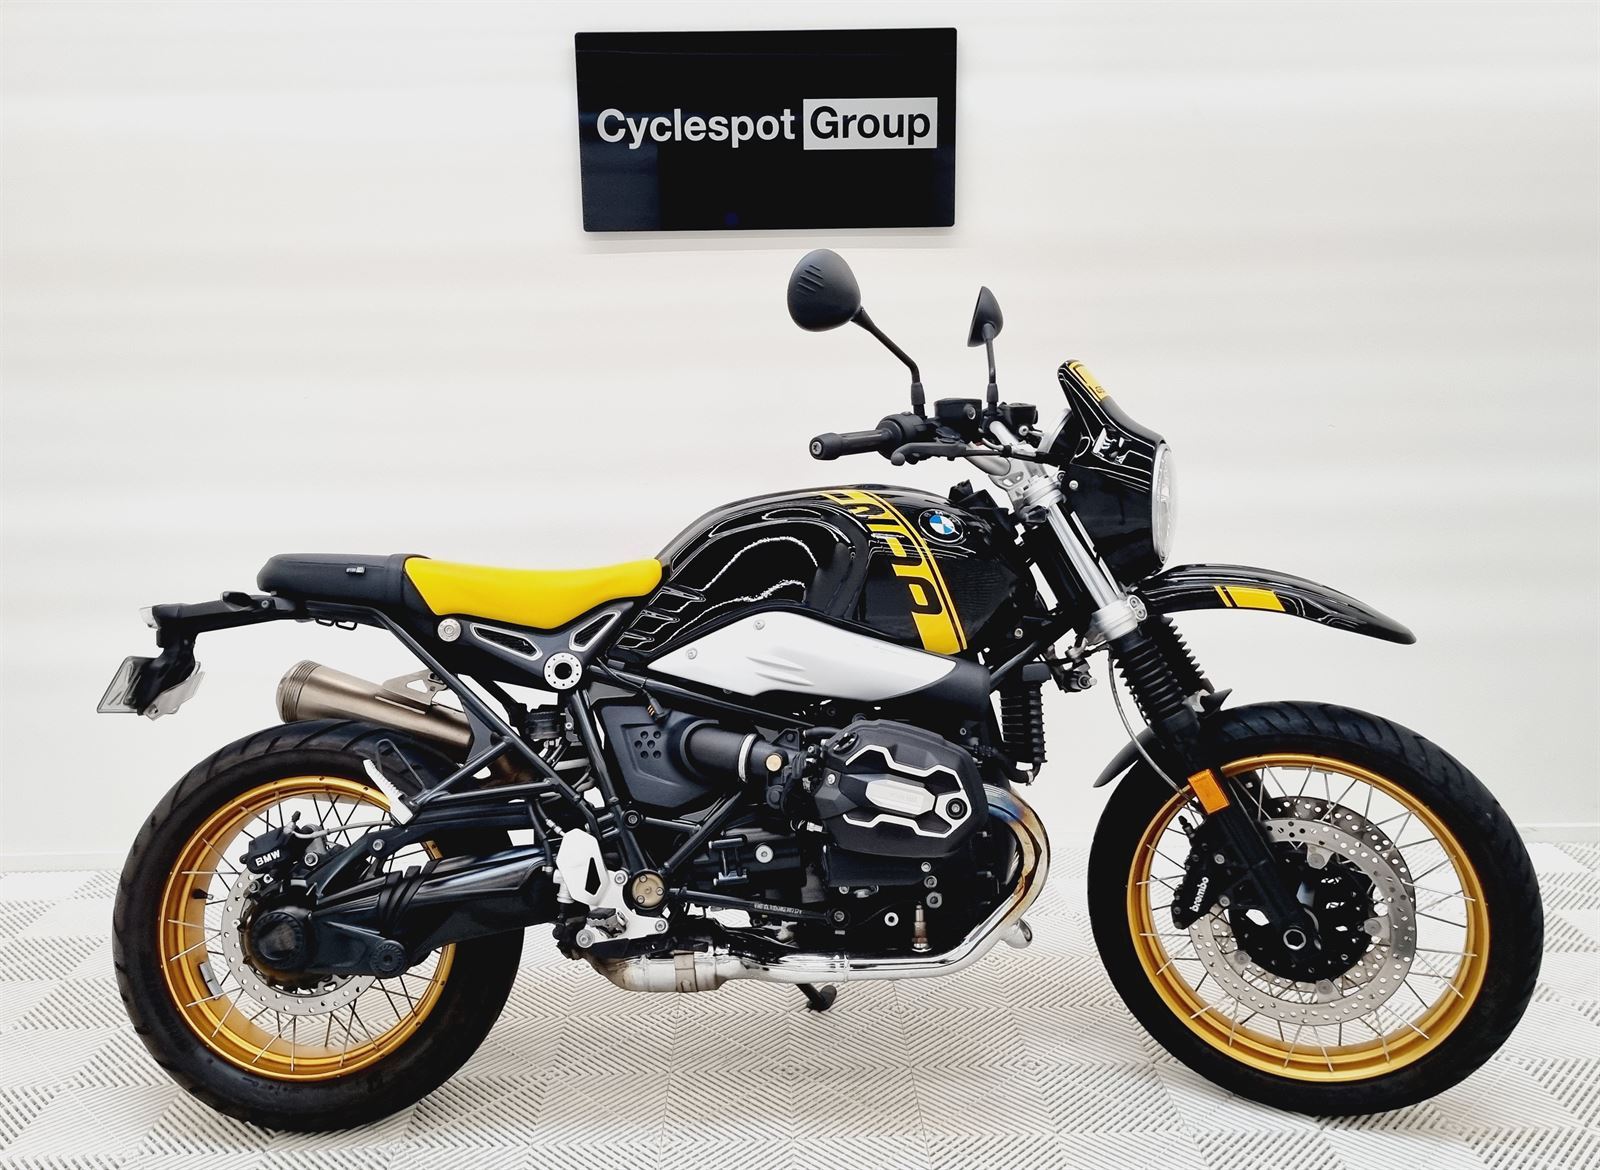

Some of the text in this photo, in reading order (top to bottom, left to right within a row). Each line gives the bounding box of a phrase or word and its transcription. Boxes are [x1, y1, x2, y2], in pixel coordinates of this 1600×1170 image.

[596, 105, 932, 150] Cyclespot Group
[255, 849, 281, 867] BMW
[1189, 876, 1210, 913] brembo
